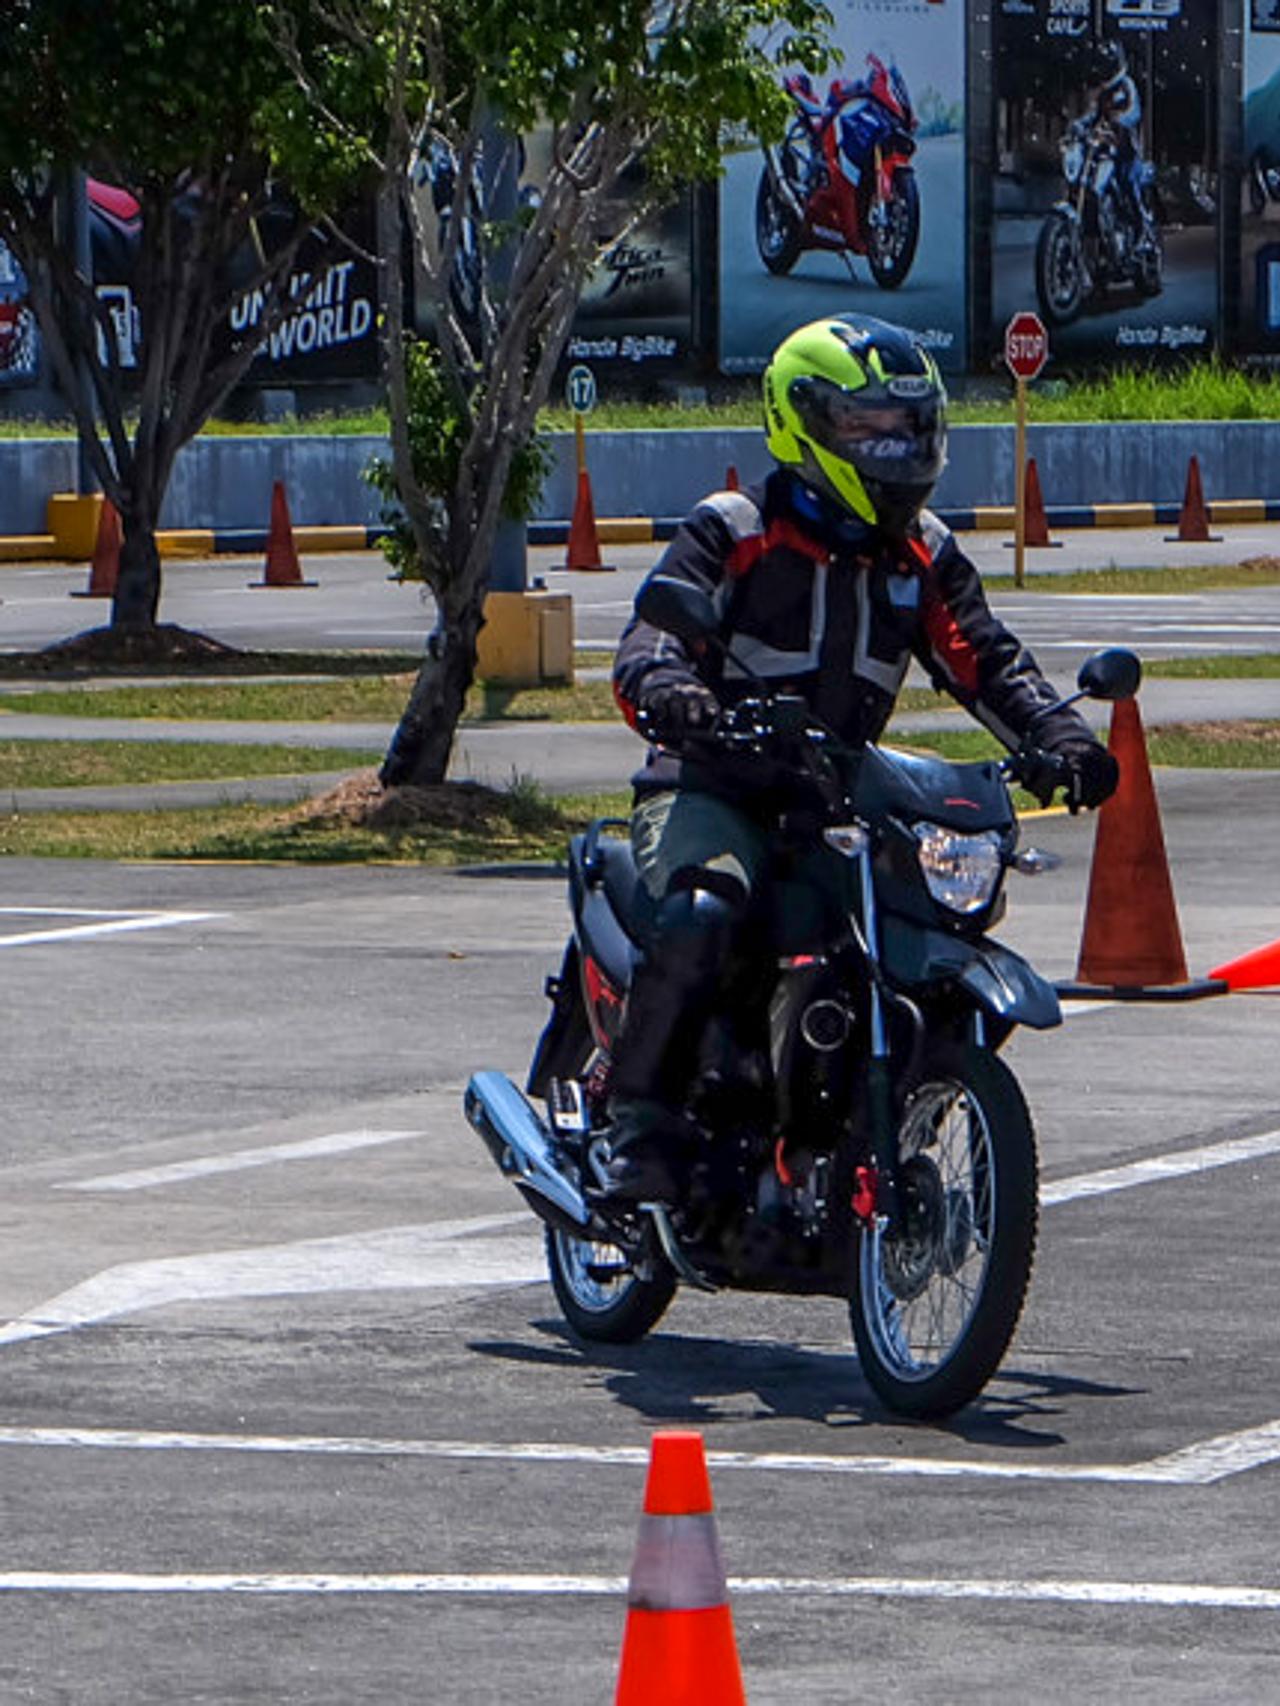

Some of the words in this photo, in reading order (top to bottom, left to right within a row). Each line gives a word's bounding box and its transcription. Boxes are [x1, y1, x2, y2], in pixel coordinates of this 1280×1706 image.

[269, 297, 372, 361] WORLD
[1009, 333, 1048, 359] STOP
[572, 376, 591, 402] 17
